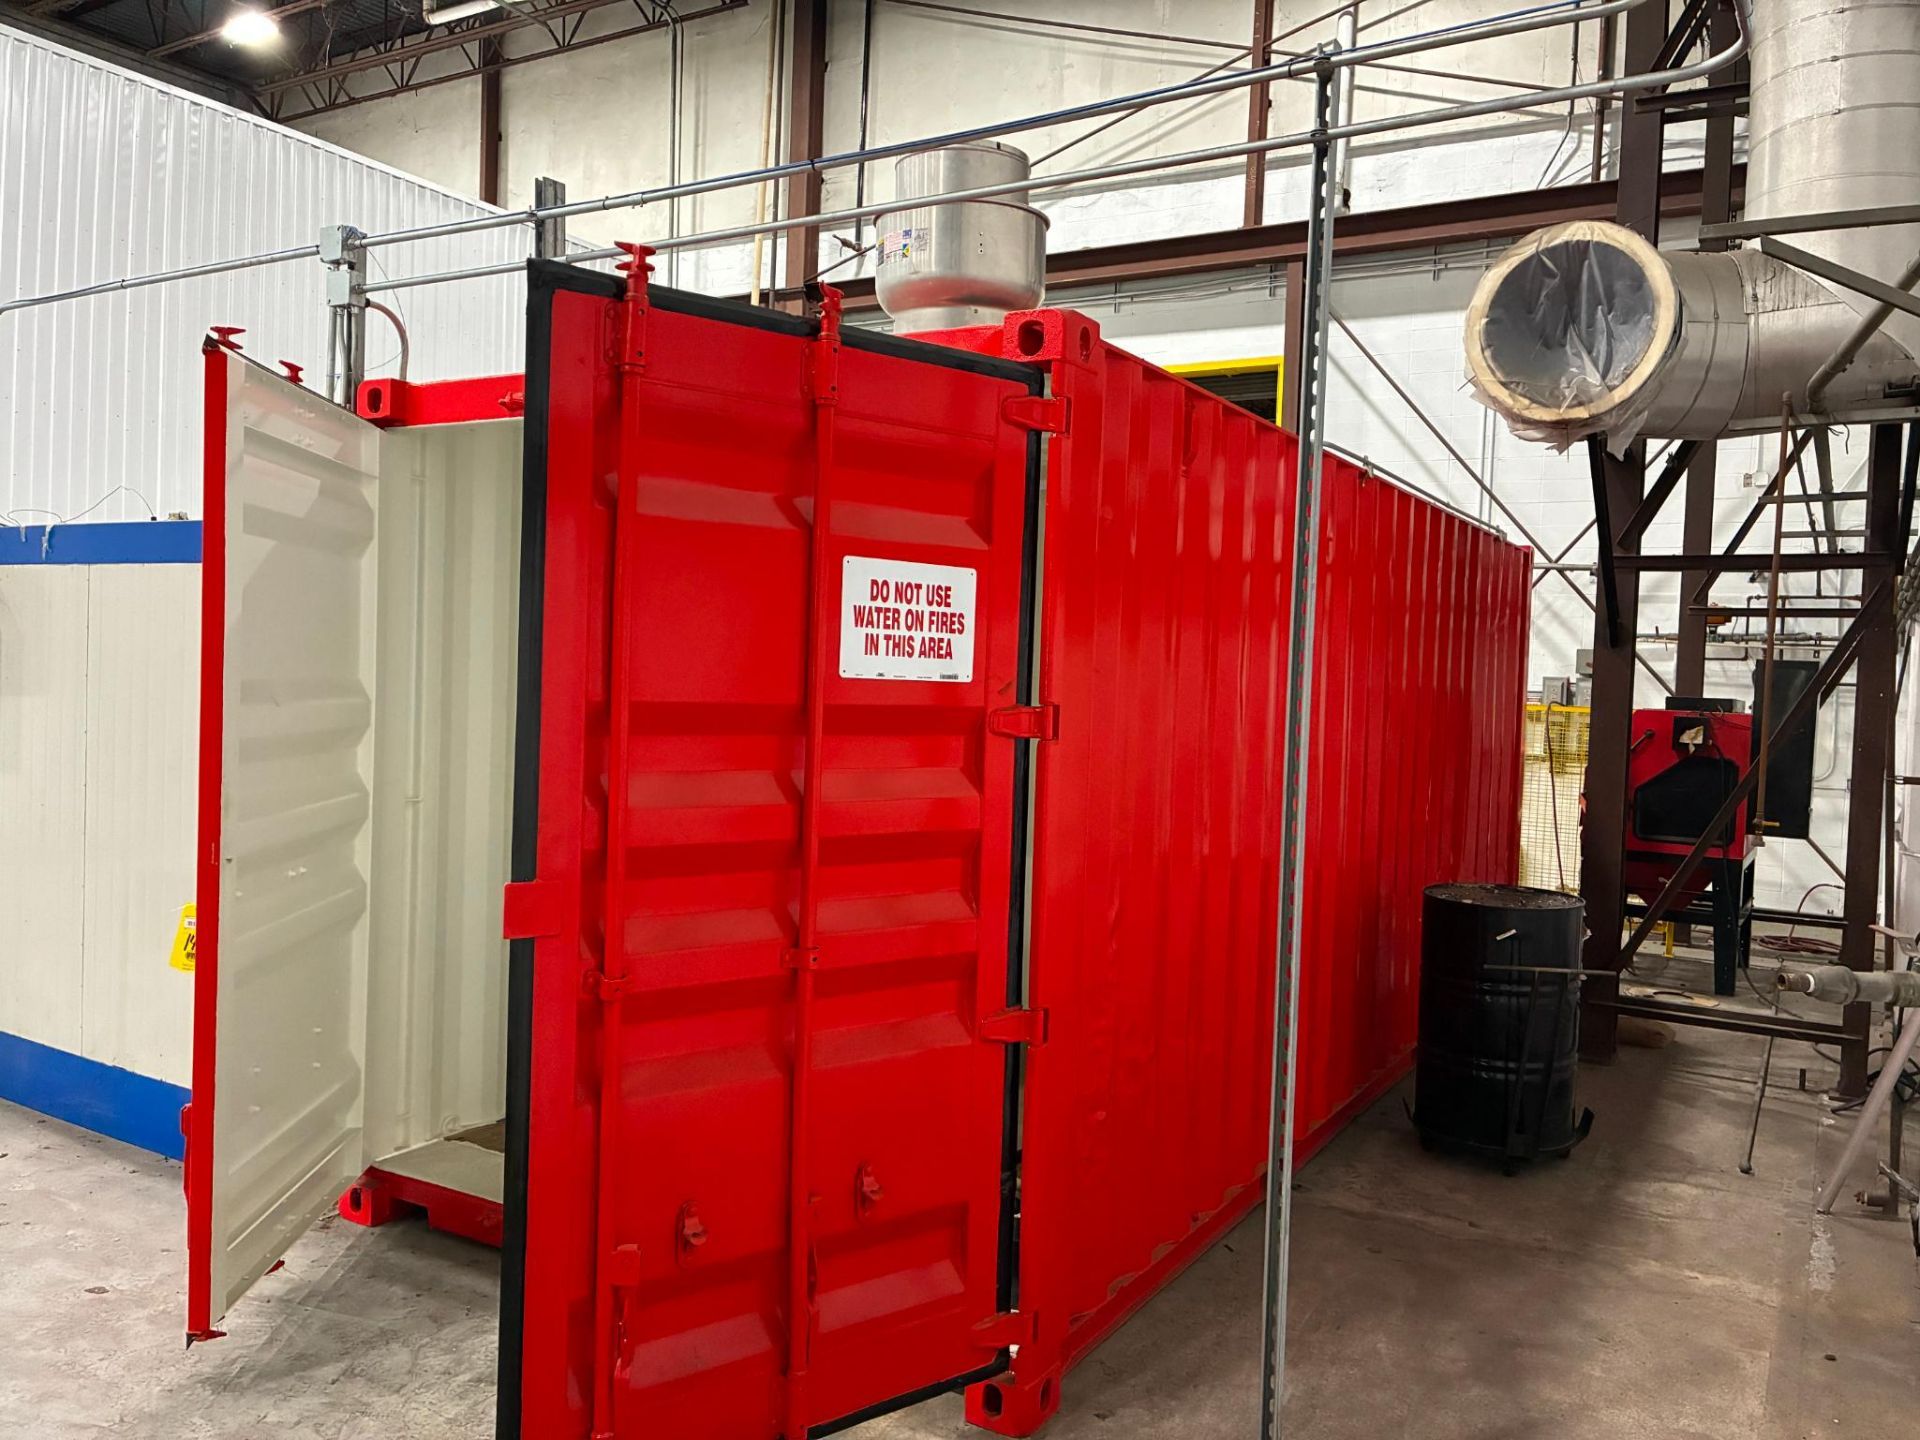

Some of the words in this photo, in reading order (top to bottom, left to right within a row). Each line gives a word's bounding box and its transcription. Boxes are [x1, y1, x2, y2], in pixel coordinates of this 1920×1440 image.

[870, 579, 890, 602] DO
[894, 581, 922, 605] NOT
[927, 584, 952, 607] USE
[853, 605, 900, 630] WATER
[905, 608, 924, 632] ON
[928, 610, 965, 635] FIRES
[864, 633, 879, 656] IN
[883, 634, 914, 658] THIS
[918, 636, 953, 659] AREA
